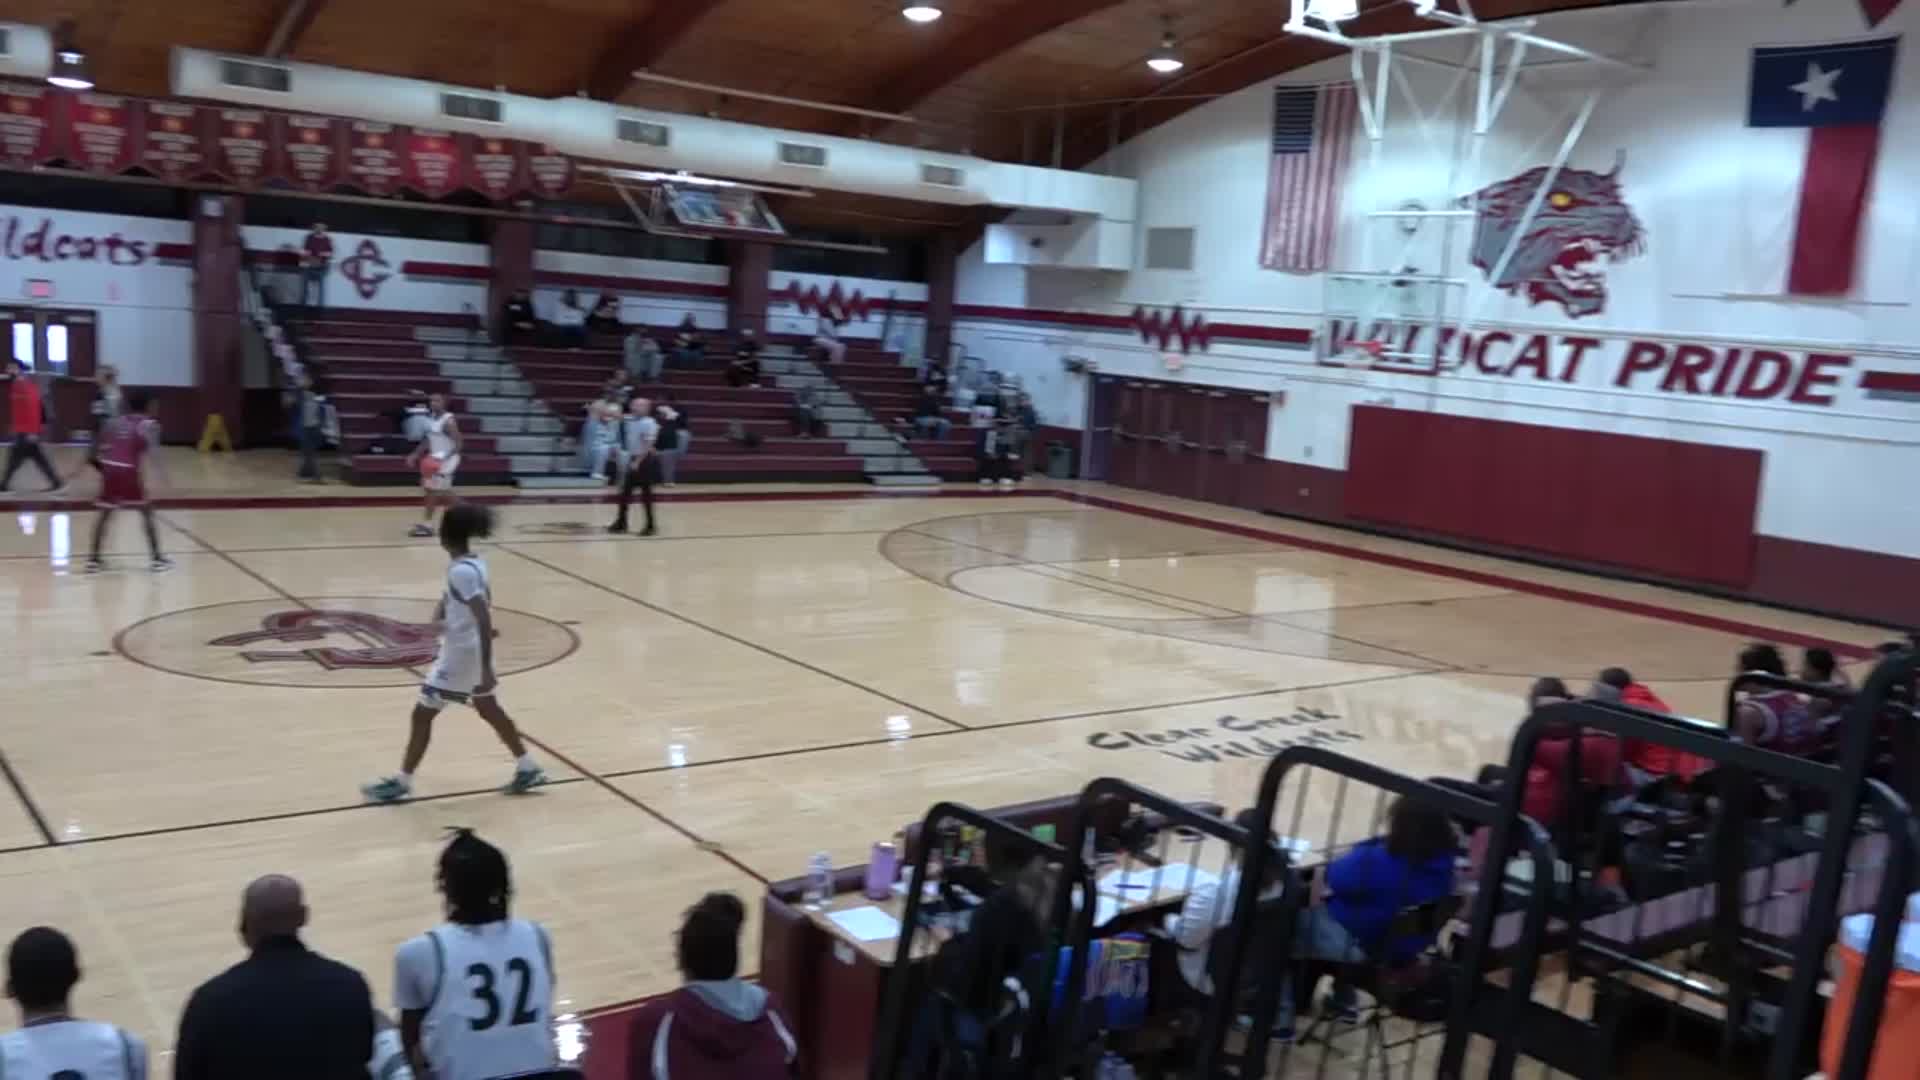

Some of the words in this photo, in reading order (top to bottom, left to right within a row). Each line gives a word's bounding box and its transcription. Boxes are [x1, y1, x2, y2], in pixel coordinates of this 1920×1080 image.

[0, 216, 146, 265] ldcats
[1613, 340, 1854, 406] PRIDE
[1087, 727, 1213, 750] Clear
[1216, 705, 1342, 731] Creek
[465, 956, 541, 1031] 32
